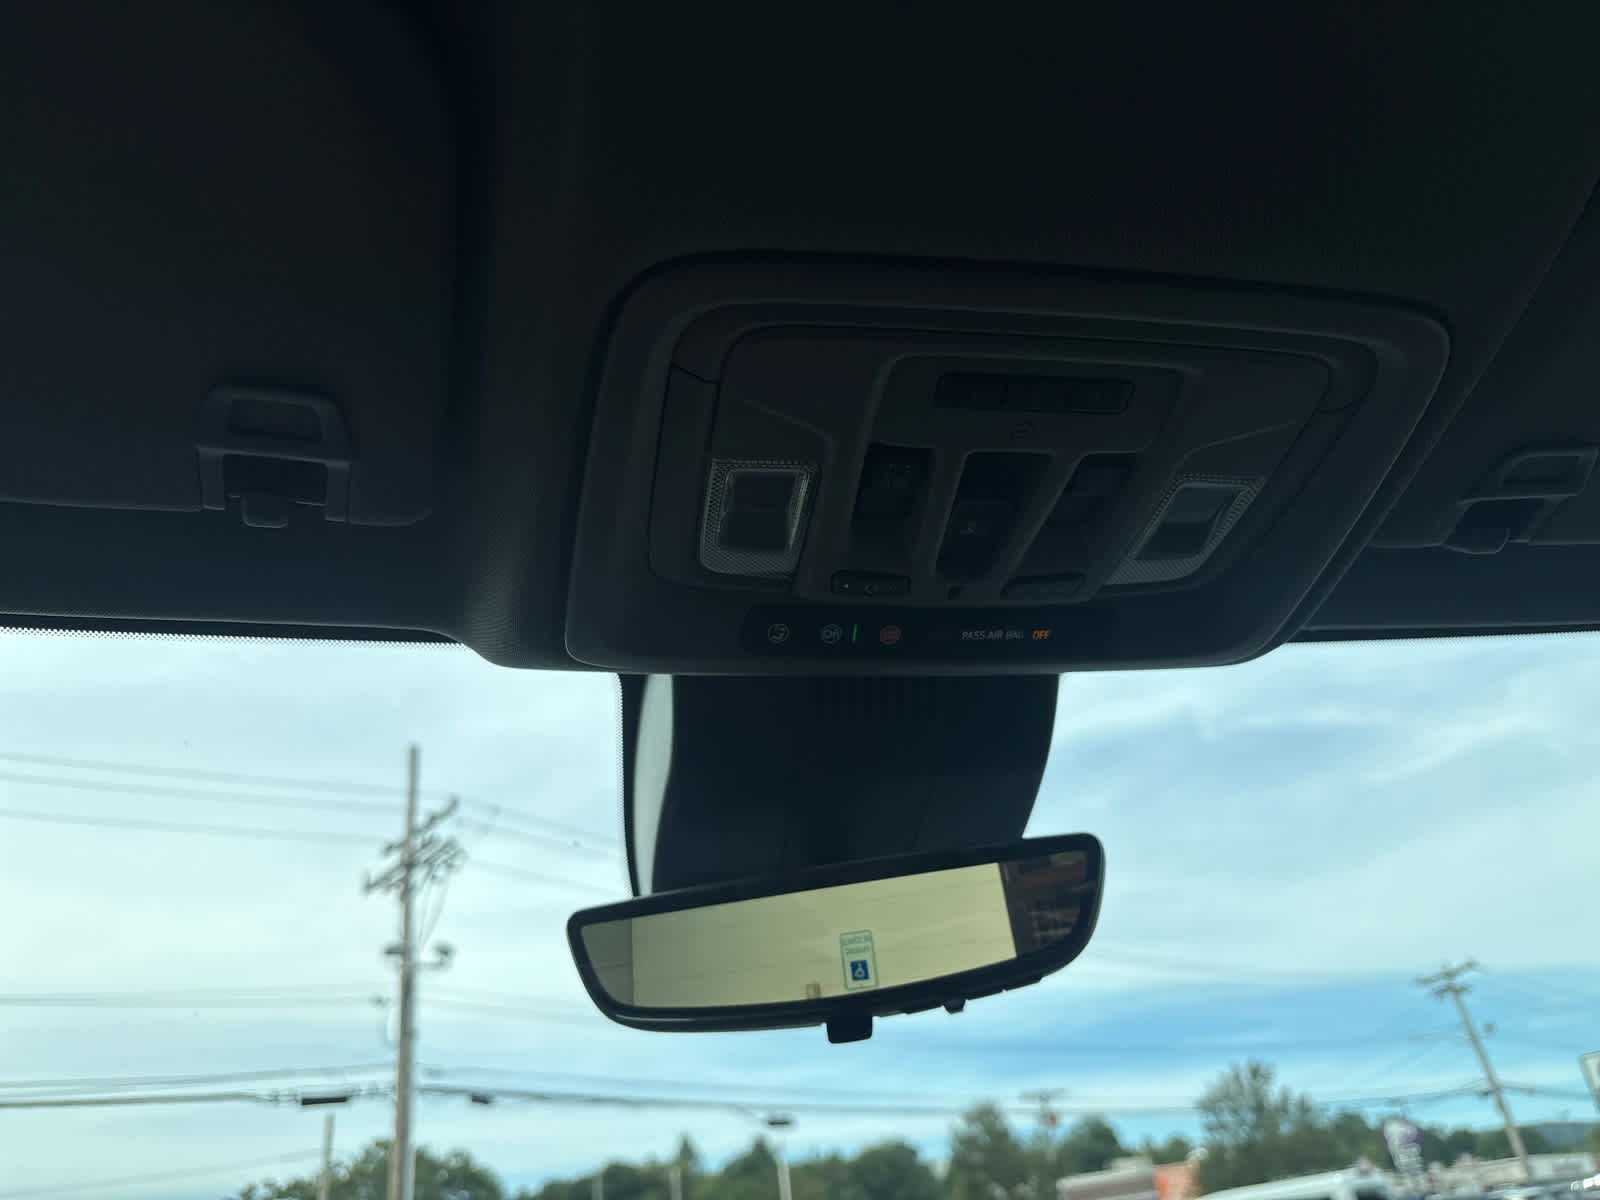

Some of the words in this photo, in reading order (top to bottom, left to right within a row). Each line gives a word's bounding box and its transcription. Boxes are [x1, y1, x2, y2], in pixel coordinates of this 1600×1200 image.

[961, 630, 985, 641] PASS
[986, 629, 1003, 641] AIR
[1031, 629, 1051, 641] OFF
